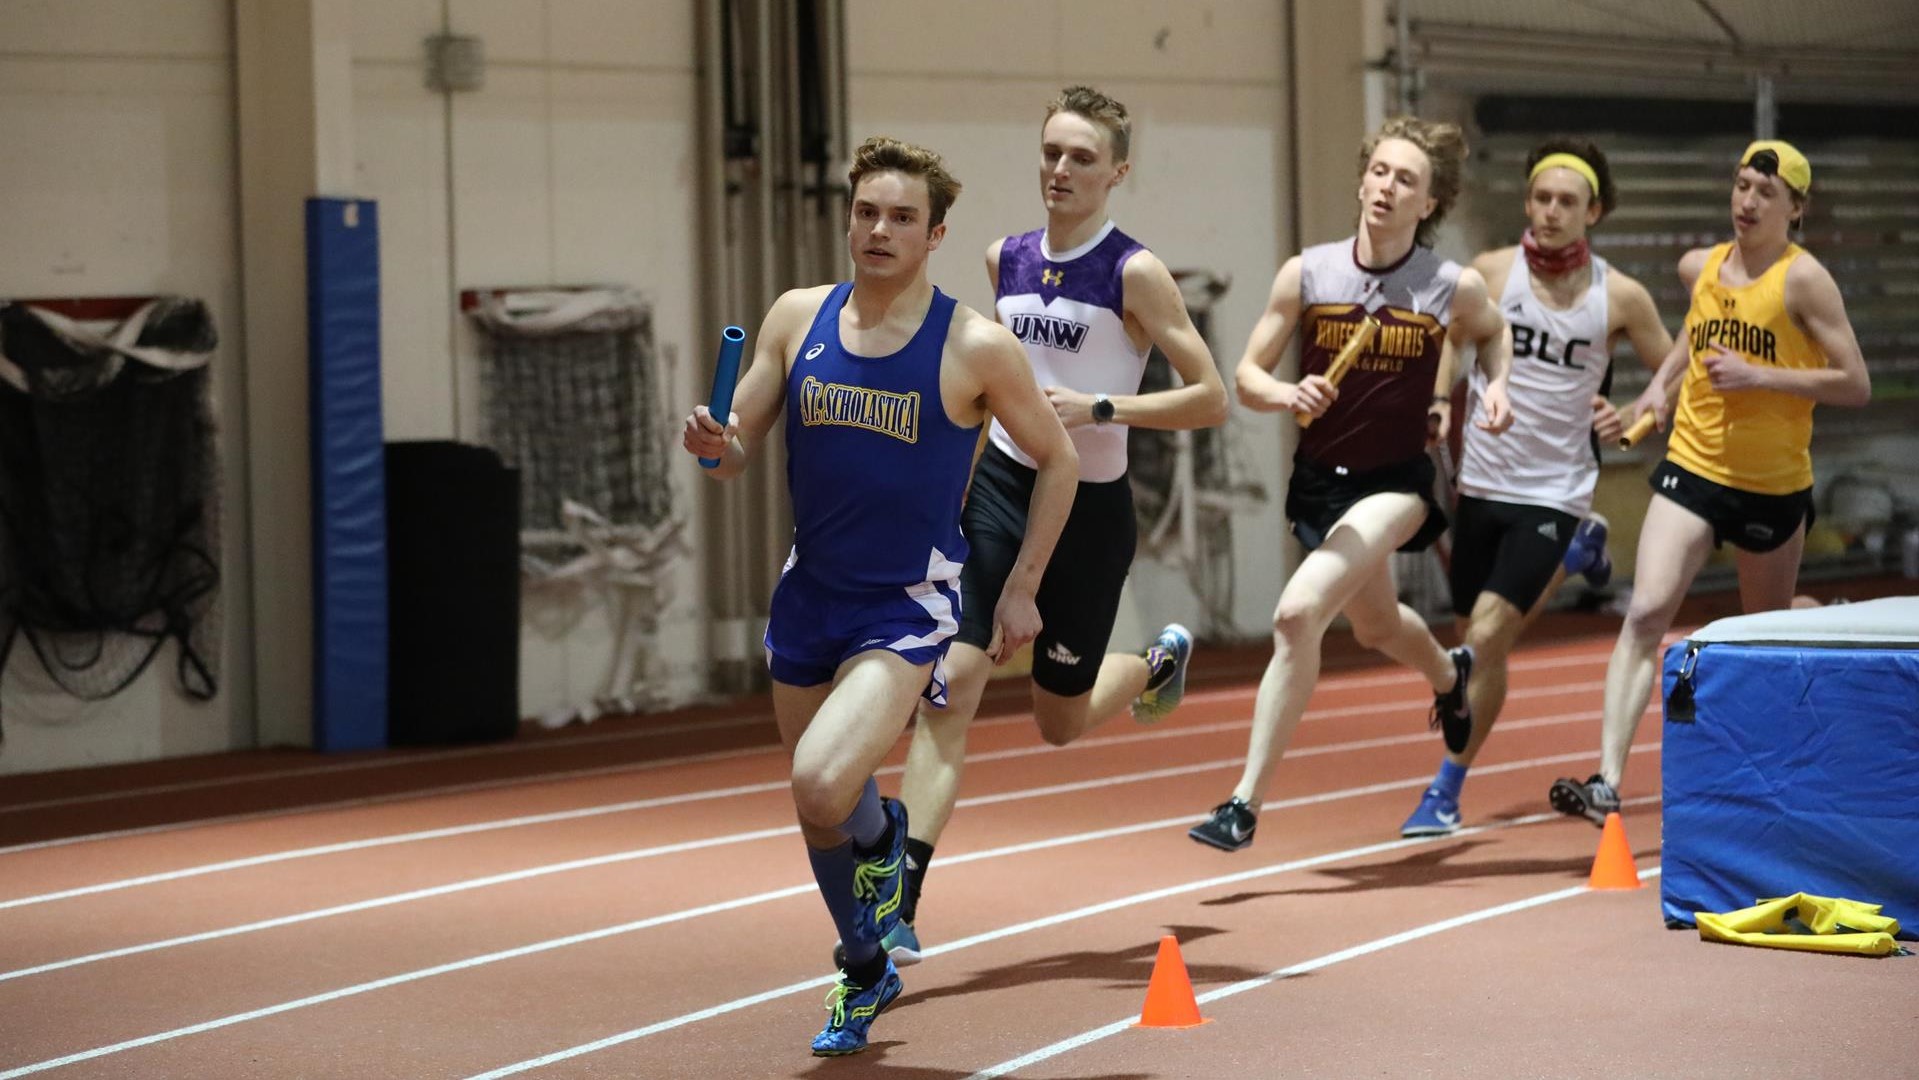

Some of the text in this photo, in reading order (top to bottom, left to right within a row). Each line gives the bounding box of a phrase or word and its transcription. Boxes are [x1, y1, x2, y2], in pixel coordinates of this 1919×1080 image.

[1010, 314, 1089, 353] UNW
[1380, 324, 1425, 358] MORRIS
[1511, 323, 1591, 370] BLC
[822, 383, 920, 443] SCHOLASTICA
[1047, 647, 1081, 665] UNW
